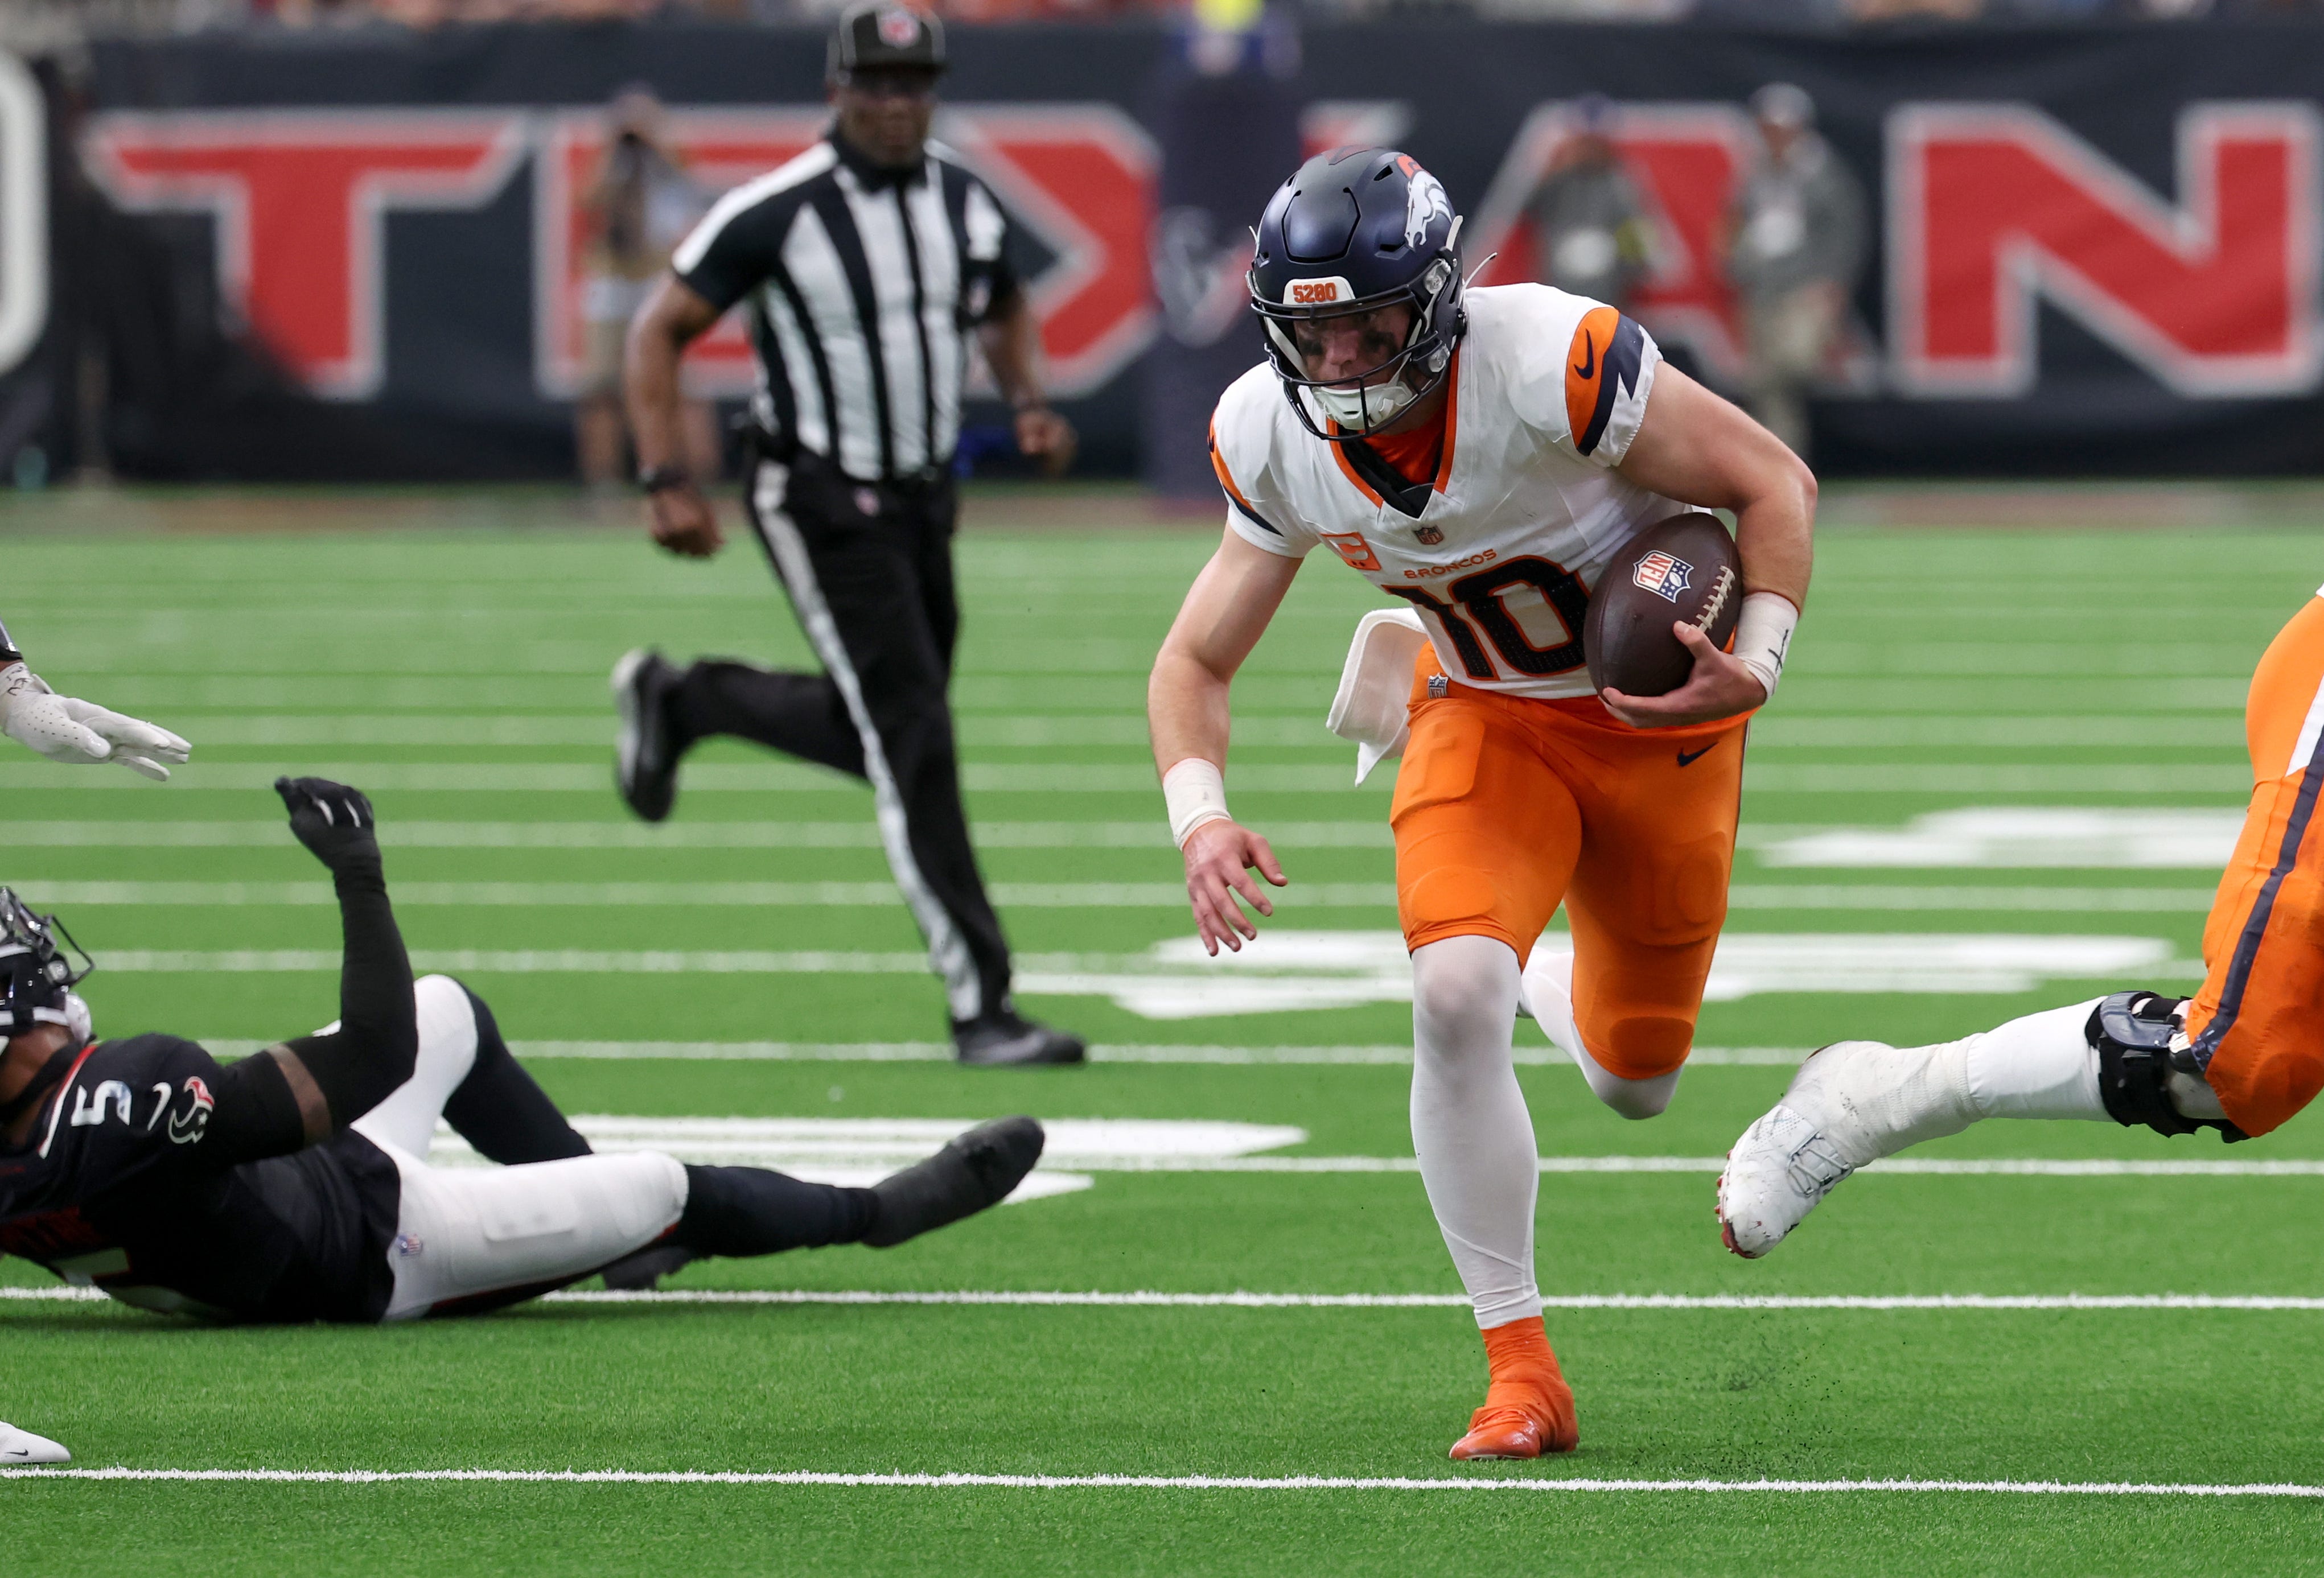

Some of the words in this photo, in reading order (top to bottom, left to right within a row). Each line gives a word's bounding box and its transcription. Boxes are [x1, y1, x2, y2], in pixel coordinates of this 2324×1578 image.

[1293, 282, 1337, 303] 5280
[1404, 549, 1498, 579] BRONCOS
[1639, 554, 1672, 585] NFL
[1381, 555, 1591, 681] 10
[71, 1080, 131, 1127] 5
